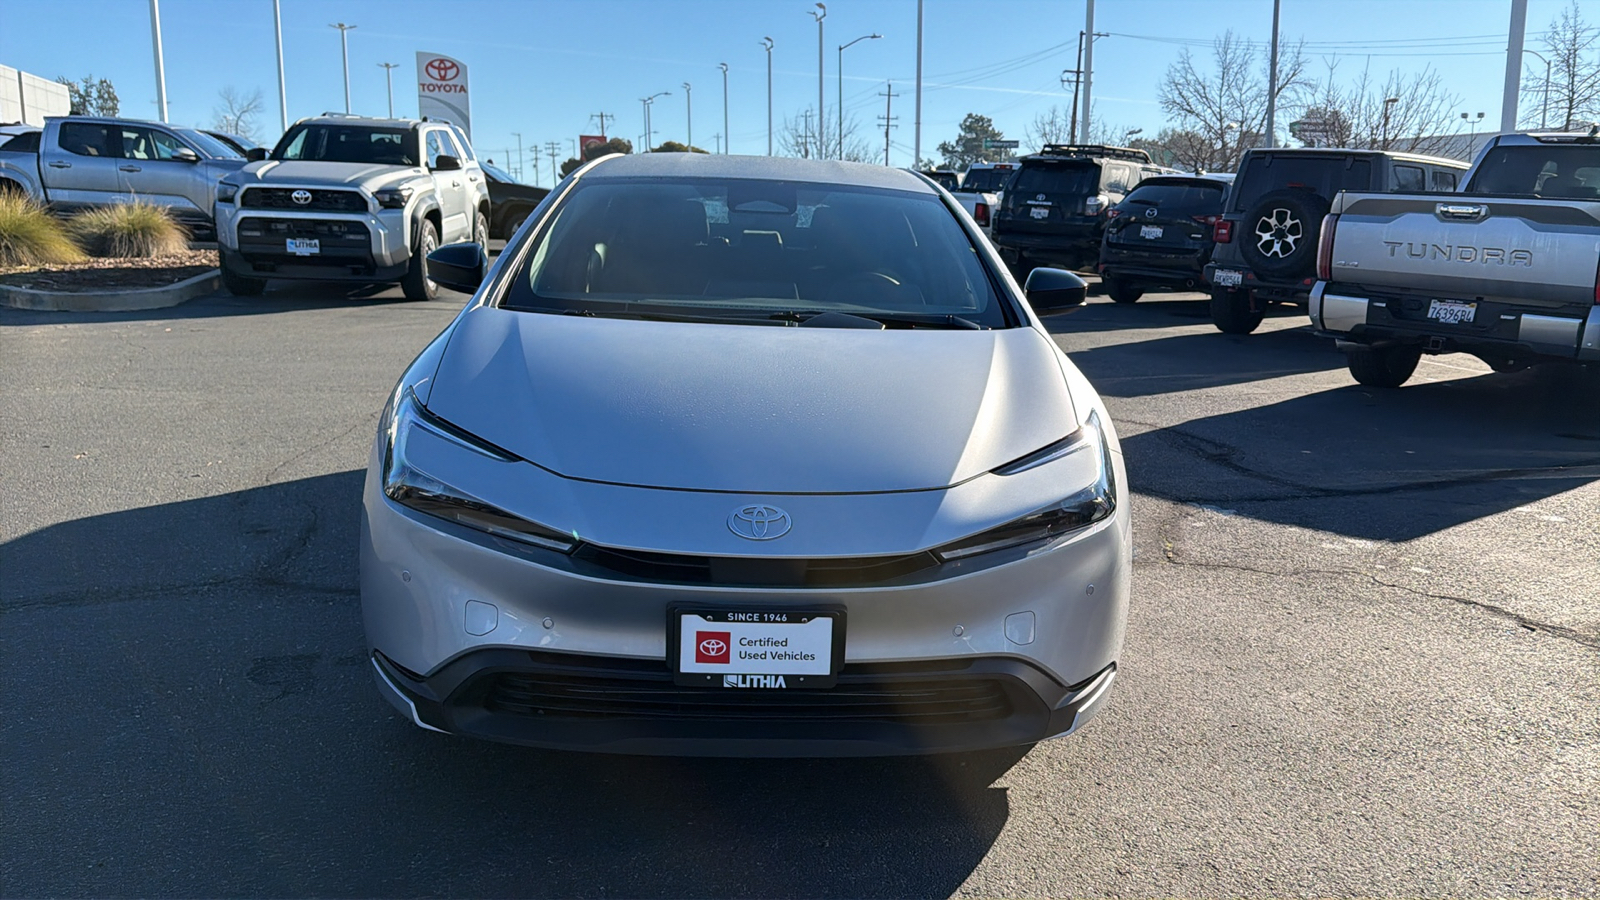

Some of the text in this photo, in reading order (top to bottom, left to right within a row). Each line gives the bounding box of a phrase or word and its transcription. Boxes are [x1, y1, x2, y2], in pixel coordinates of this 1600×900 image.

[419, 83, 467, 93] TOYOTA
[1383, 241, 1533, 267] TUNDRA
[727, 612, 788, 622] SINCE 1946
[739, 637, 788, 647] Certified
[739, 651, 815, 661] Used Vehicles
[737, 675, 786, 688] LITHIA
